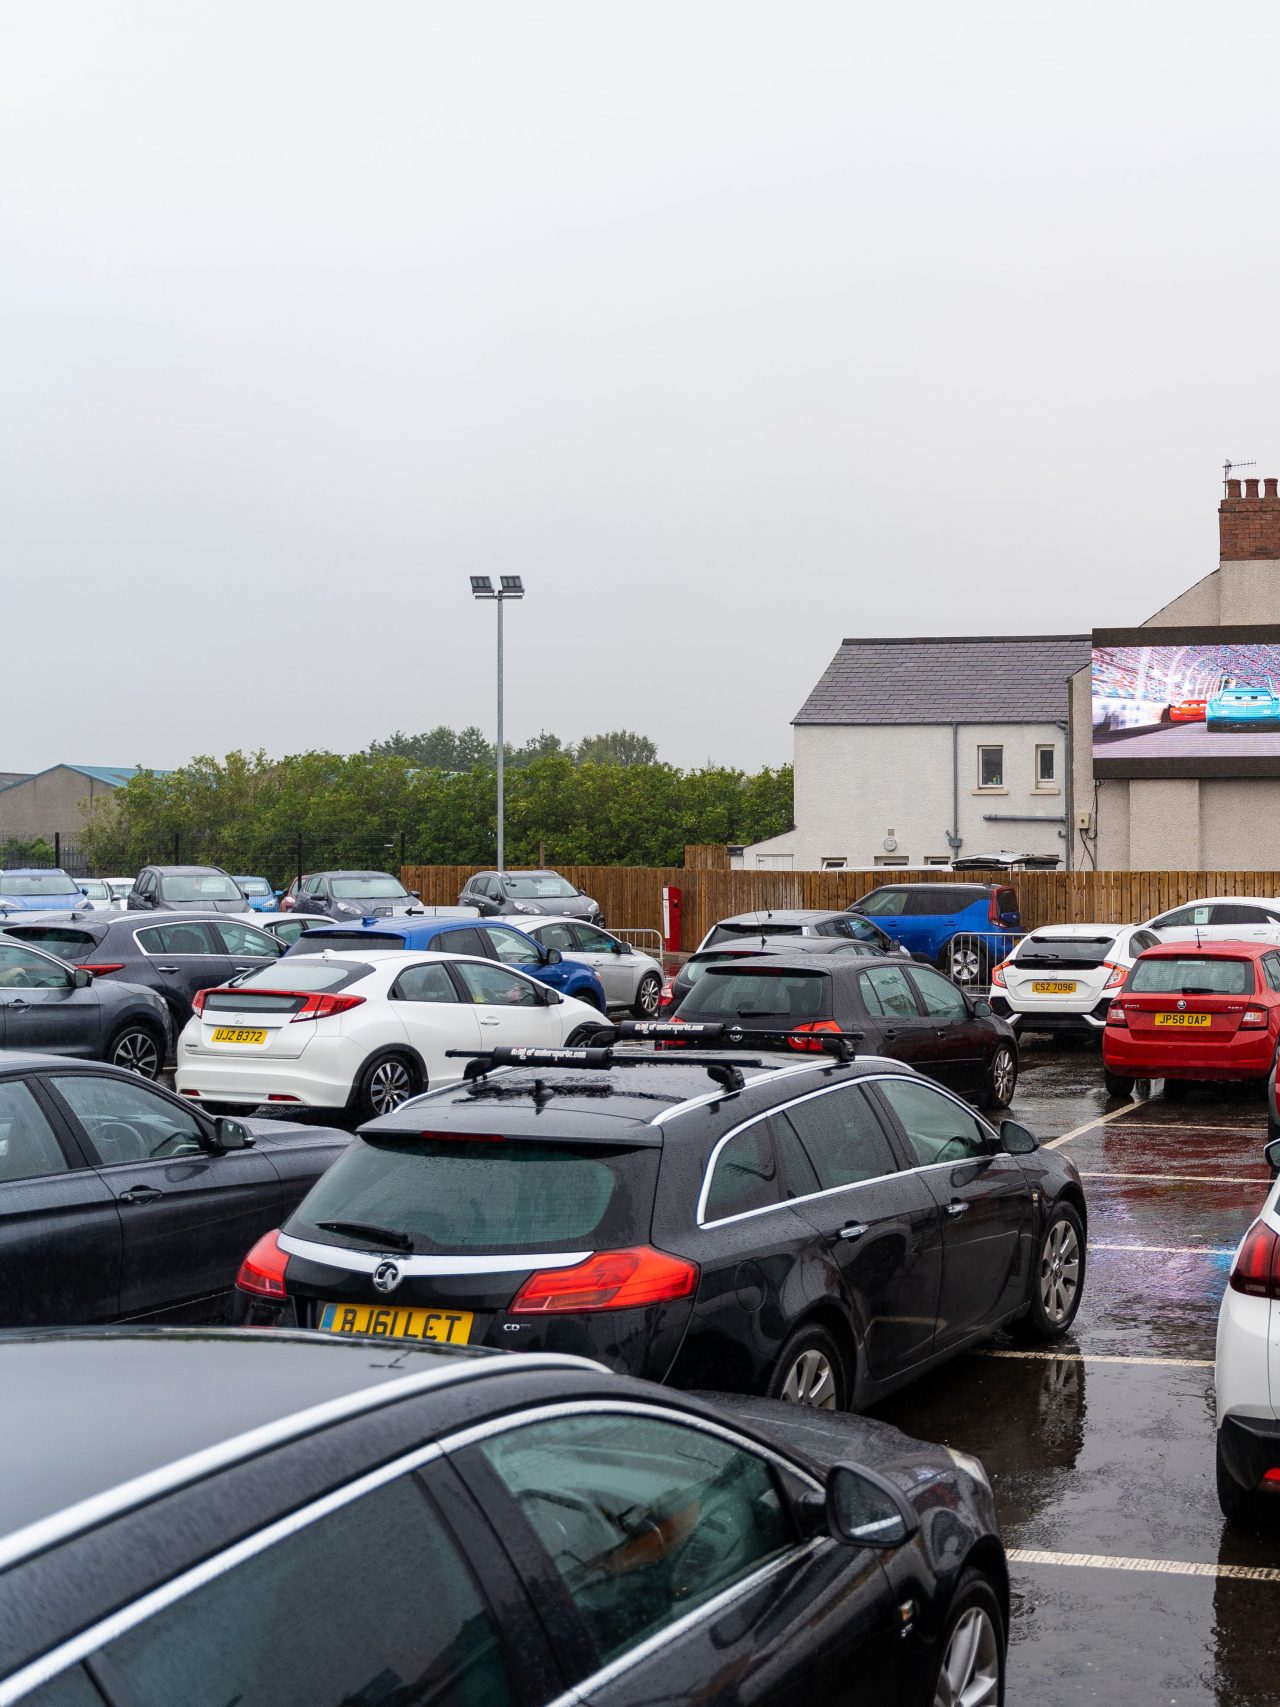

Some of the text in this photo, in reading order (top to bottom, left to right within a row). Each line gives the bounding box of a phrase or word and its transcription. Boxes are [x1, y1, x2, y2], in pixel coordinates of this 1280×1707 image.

[1035, 982, 1073, 991] CSZ 7096
[1159, 1014, 1186, 1025] JP58
[215, 1030, 263, 1042] UJZ 8372
